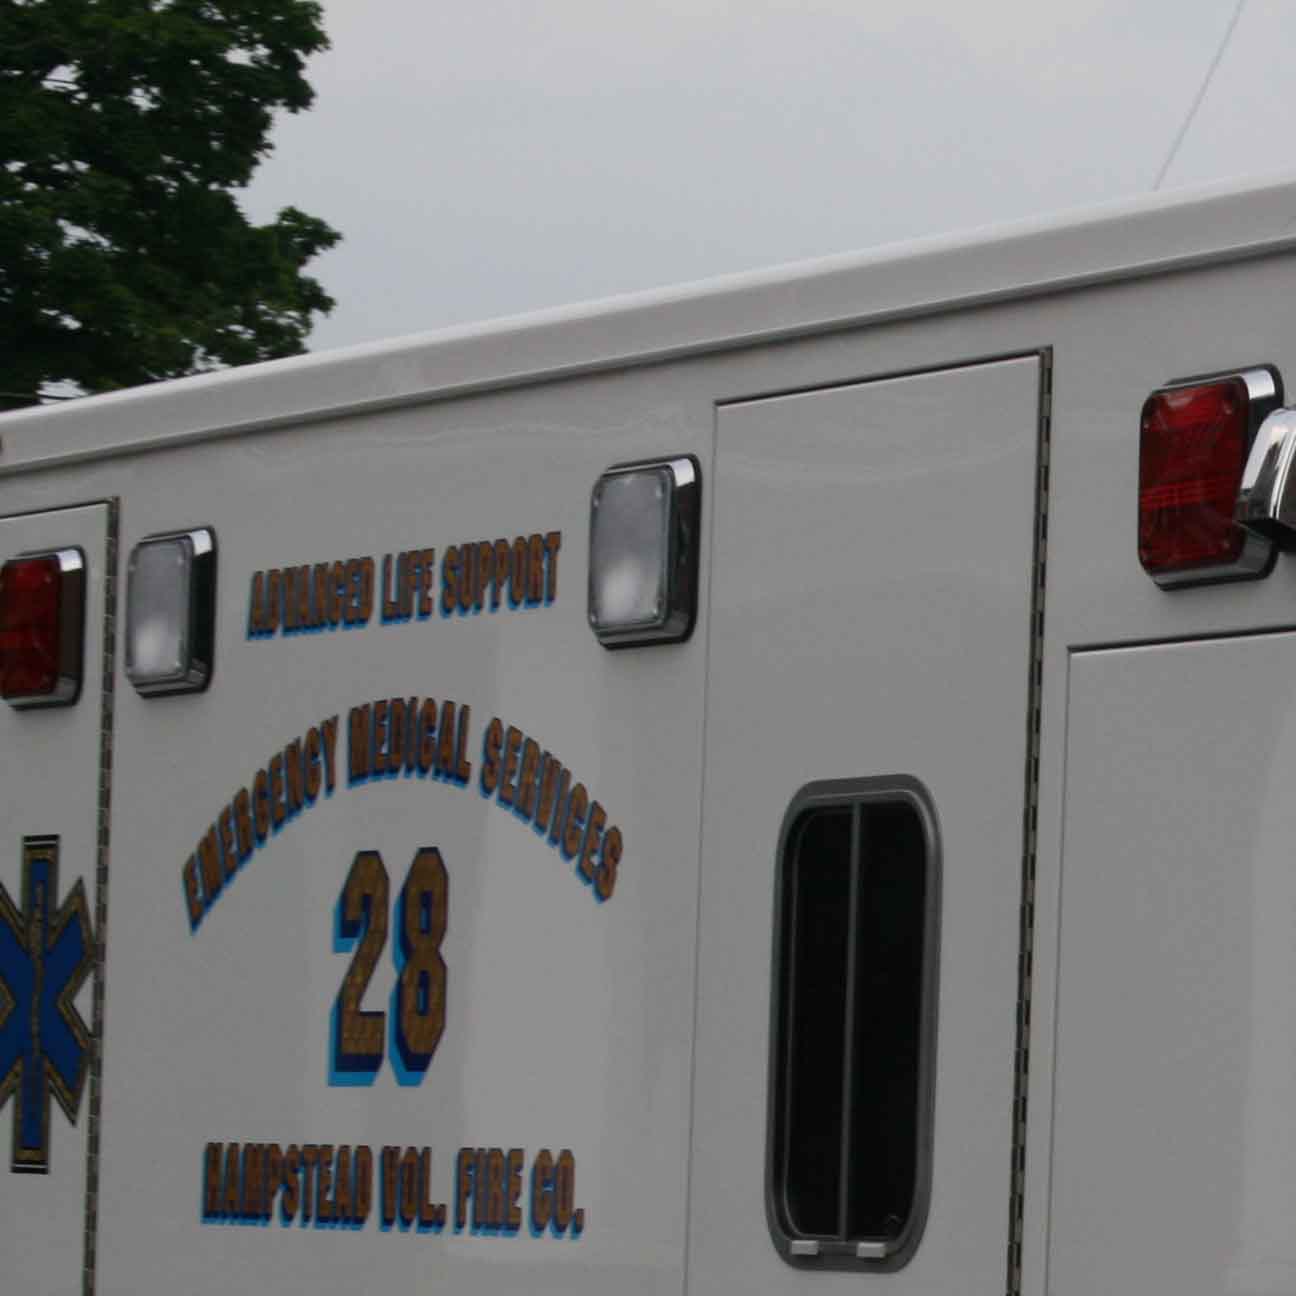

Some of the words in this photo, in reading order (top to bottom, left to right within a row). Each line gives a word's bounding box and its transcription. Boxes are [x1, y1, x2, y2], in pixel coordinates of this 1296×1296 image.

[248, 556, 374, 640] ADVANCED
[381, 548, 435, 624] LIFE
[442, 531, 562, 618] SUPPORT
[182, 715, 338, 936] EMERGENCY
[347, 697, 472, 789] MEDICAL
[480, 717, 624, 904] SERVICES
[328, 846, 449, 1087] 28
[202, 1142, 373, 1230] HAMPSTEAD
[380, 1145, 447, 1233] VOL.
[454, 1146, 525, 1237] FIRE
[530, 1148, 586, 1240] CO.
